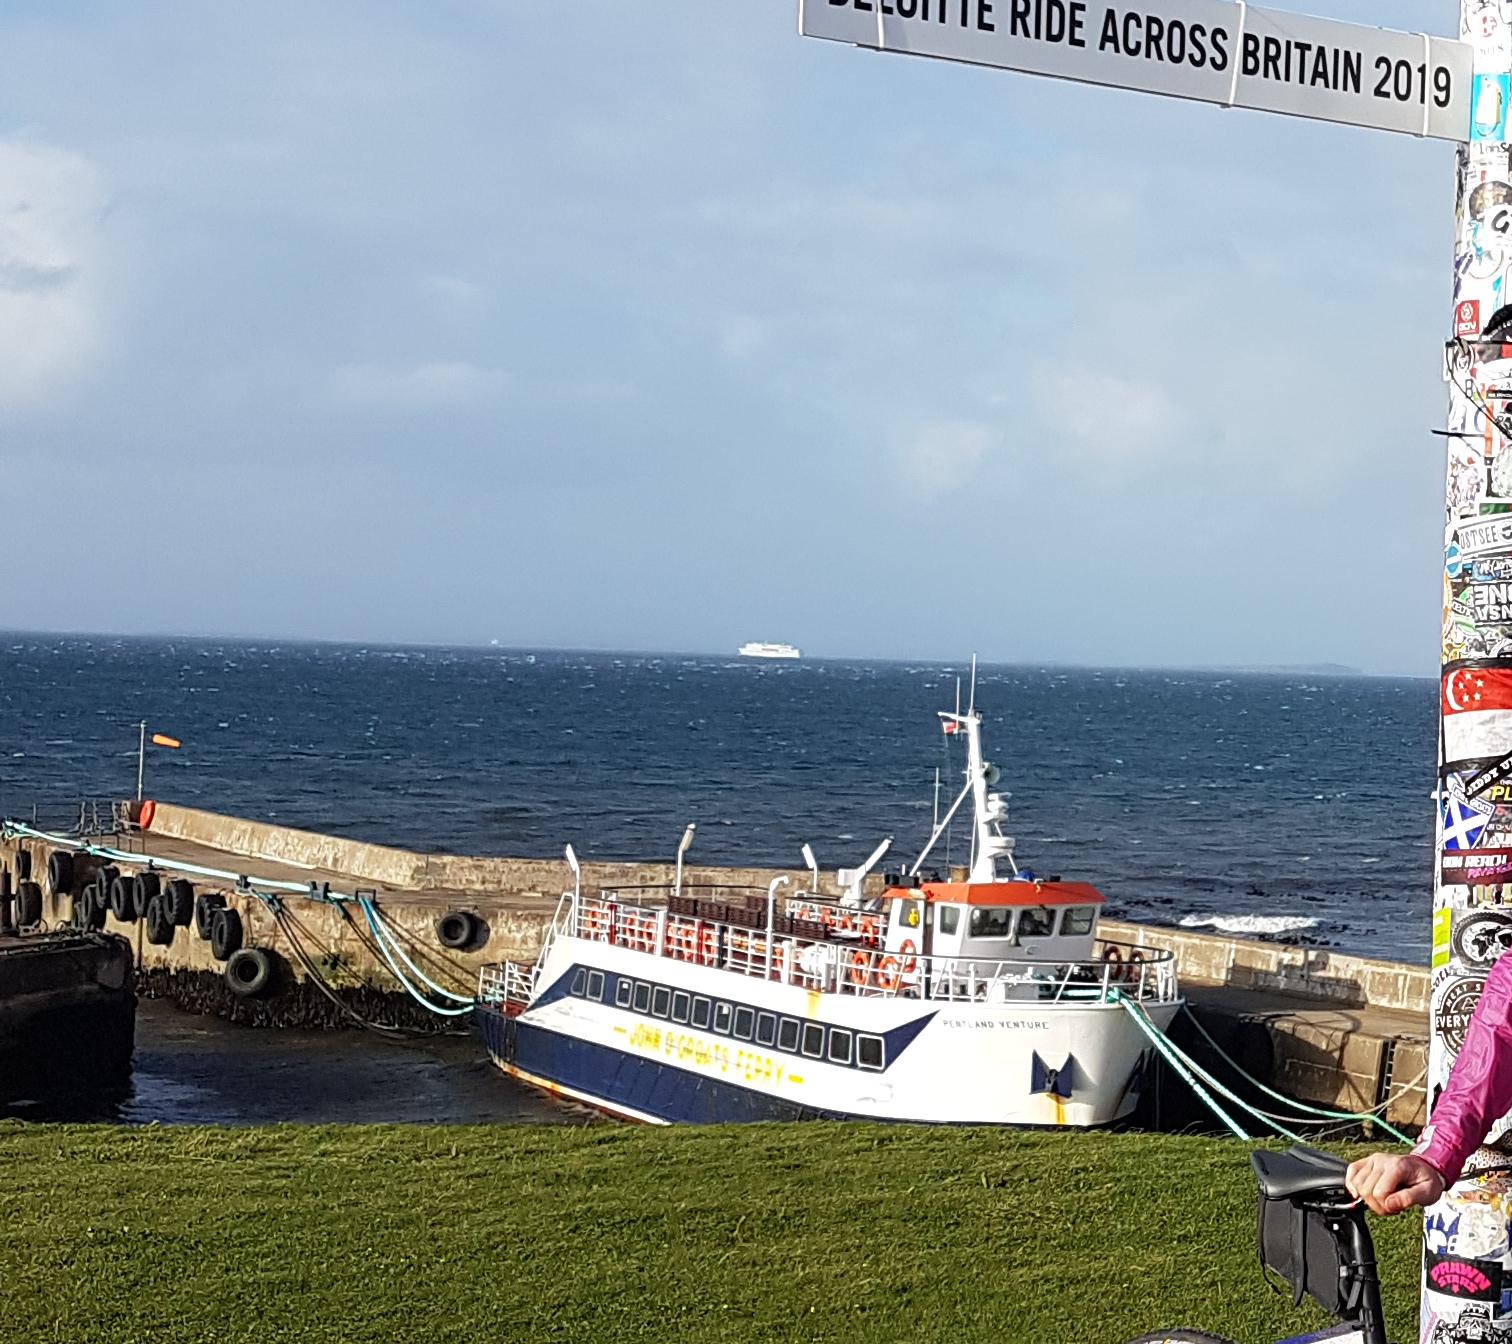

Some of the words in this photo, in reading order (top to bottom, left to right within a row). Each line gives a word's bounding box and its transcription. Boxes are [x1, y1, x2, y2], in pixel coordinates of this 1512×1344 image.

[1099, 7, 1228, 72] ACROSS
[1241, 32, 1362, 94] BRITAIN
[1373, 56, 1451, 108] 2019
[1460, 525, 1499, 549] OSTSEE
[1446, 983, 1468, 1008] NEXT
[942, 1019, 995, 1030] PENTLAND
[999, 1020, 1050, 1031] VENTURE
[1430, 1261, 1492, 1291] PRAWN
